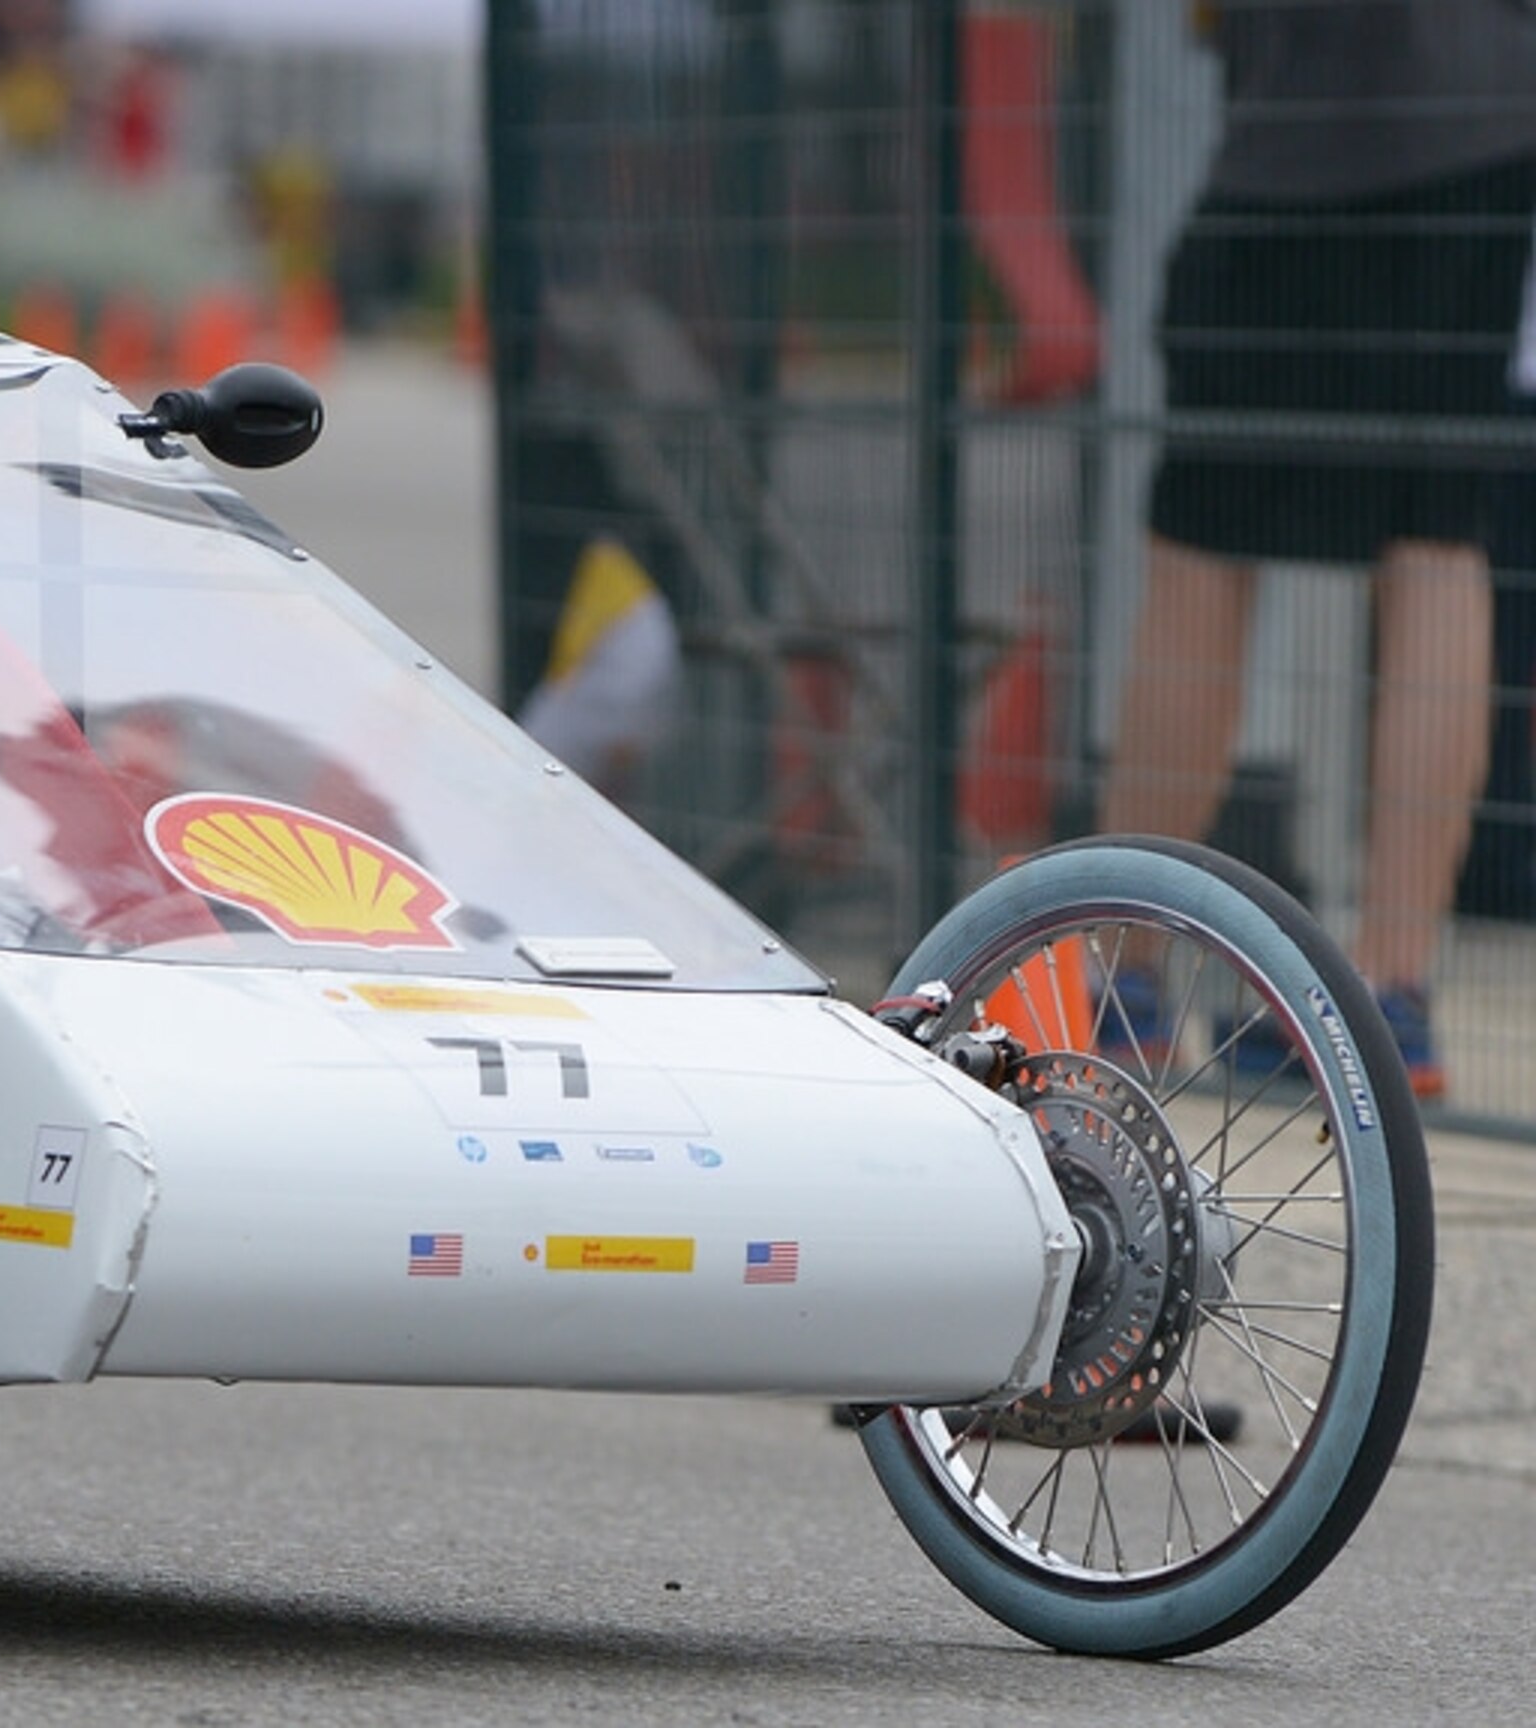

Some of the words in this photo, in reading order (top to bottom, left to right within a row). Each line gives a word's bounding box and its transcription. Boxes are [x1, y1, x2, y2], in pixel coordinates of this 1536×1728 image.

[424, 1036, 590, 1099] 77
[1320, 1015, 1374, 1128] MICHELIN
[39, 1152, 73, 1184] 77
